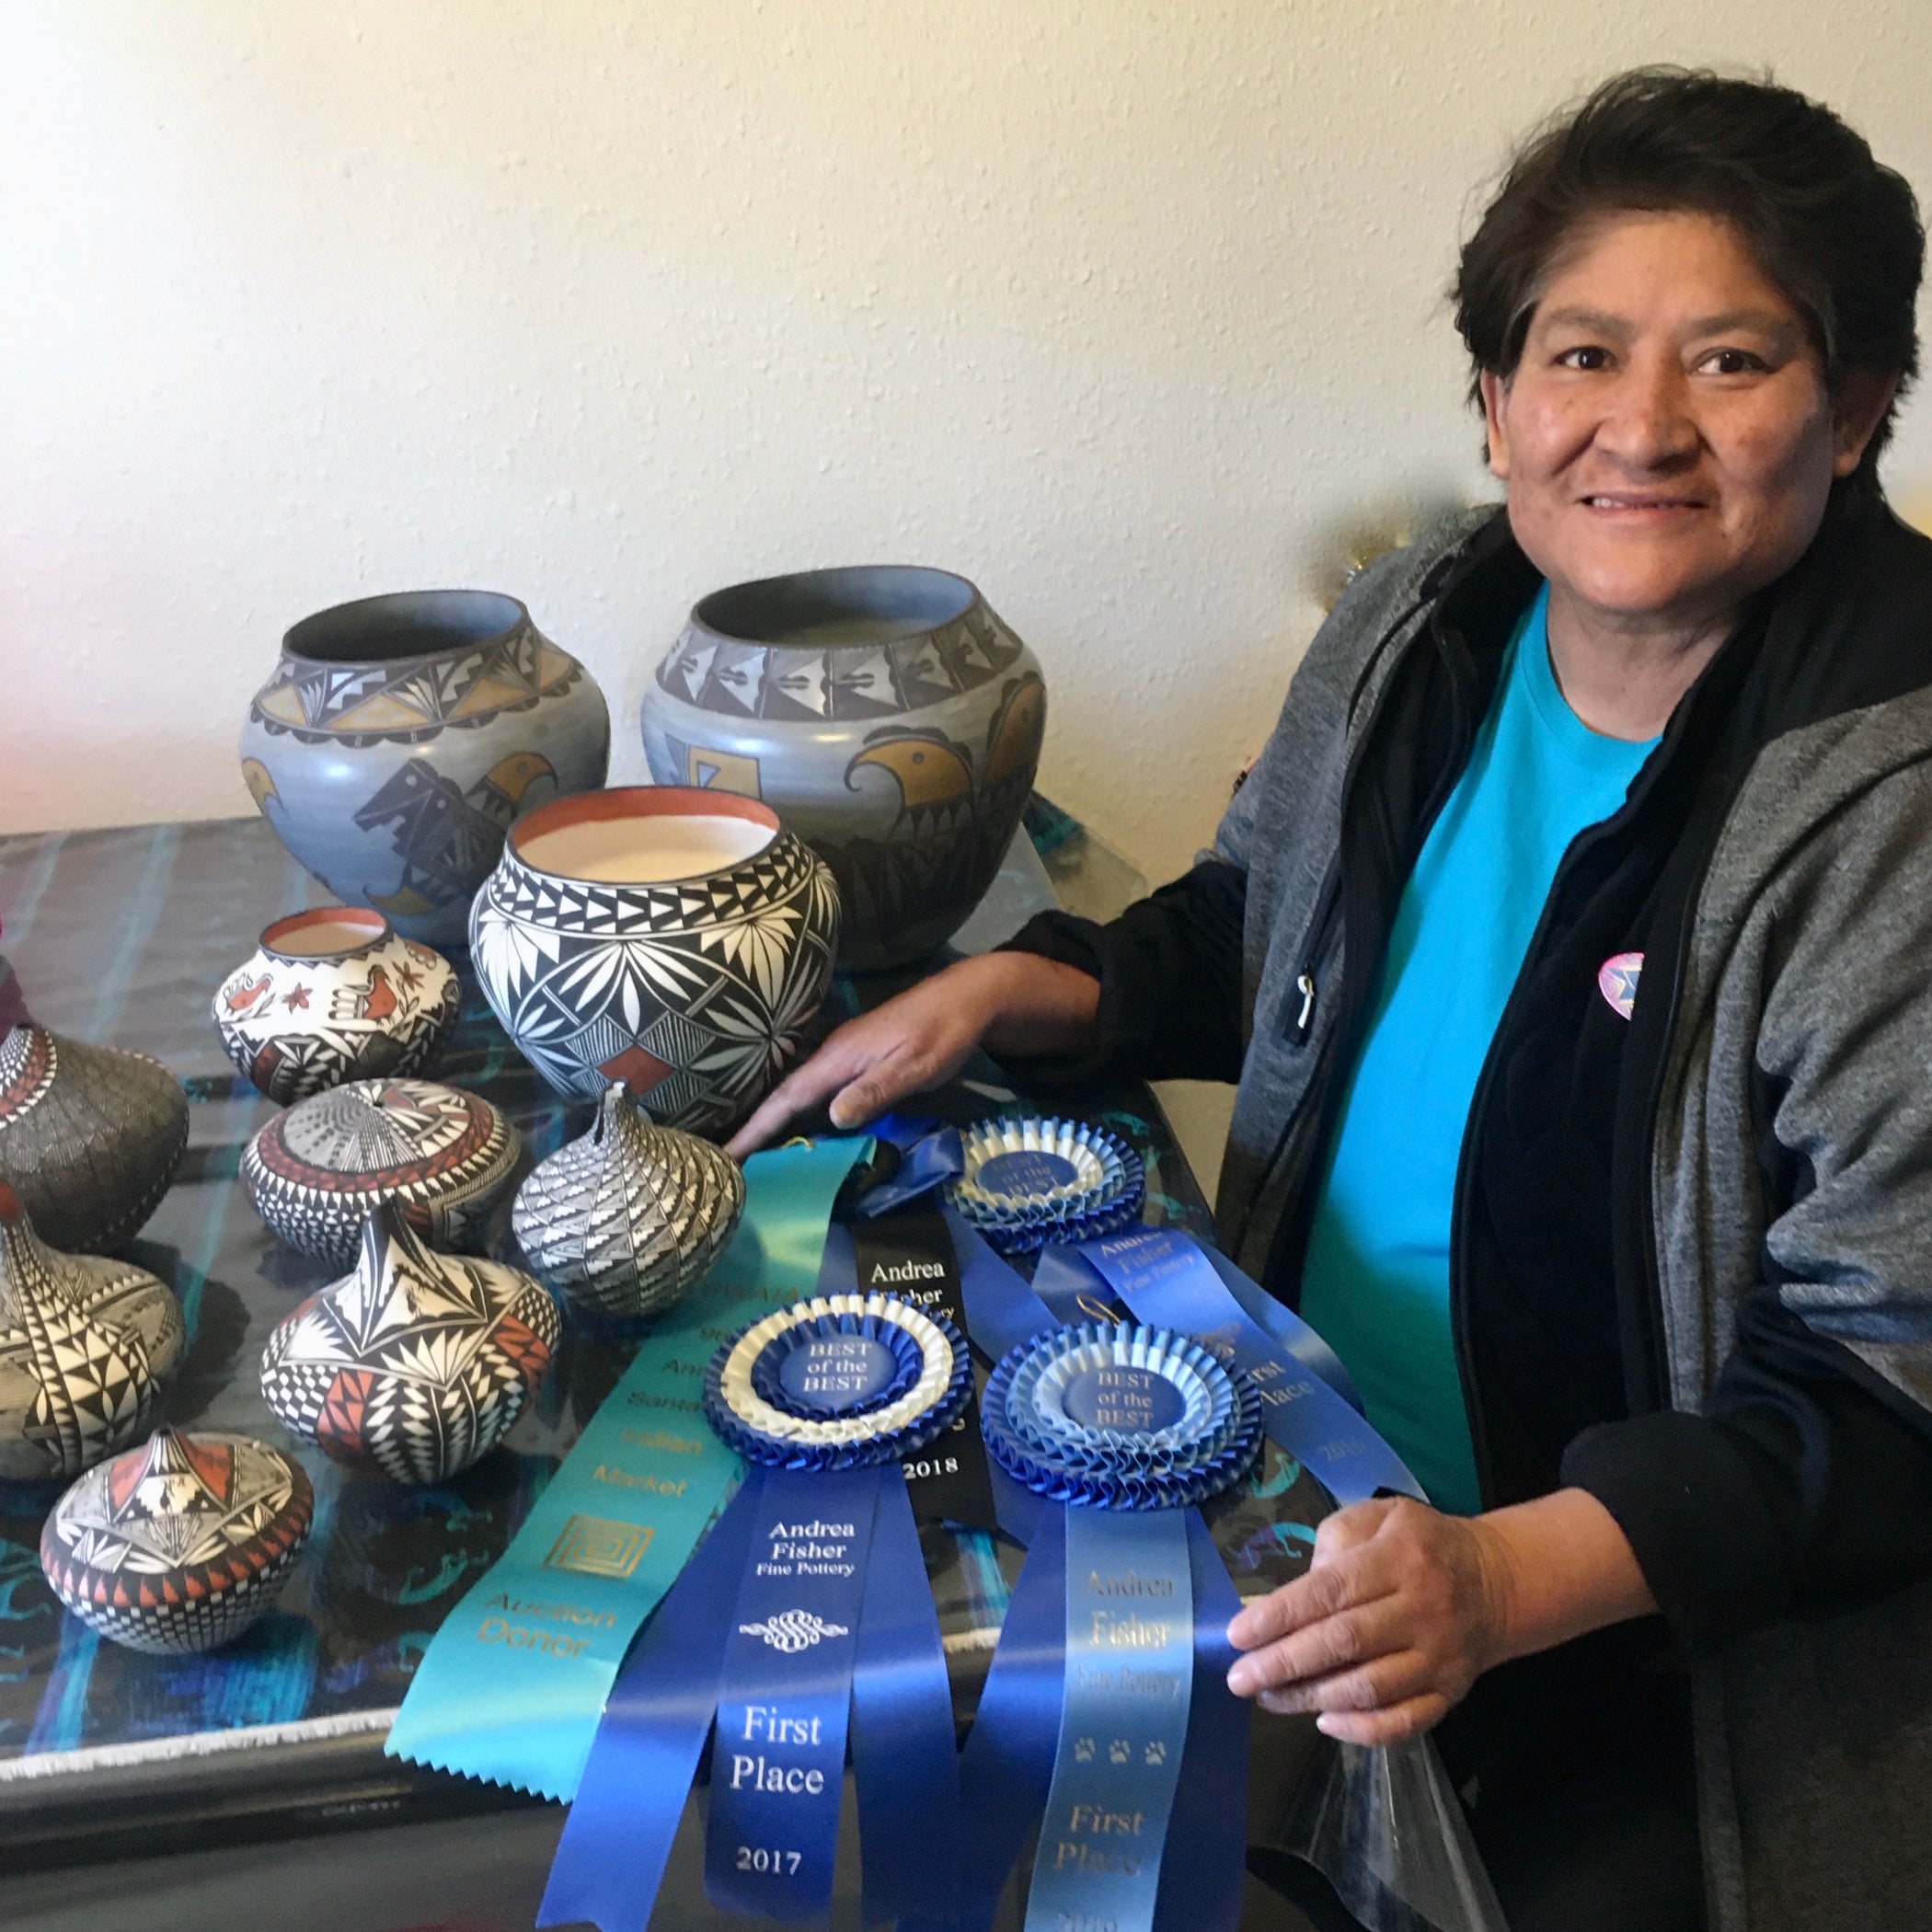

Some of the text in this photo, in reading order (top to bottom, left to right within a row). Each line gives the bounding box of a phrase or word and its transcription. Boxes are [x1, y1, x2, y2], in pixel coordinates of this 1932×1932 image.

[871, 1259, 946, 1283] Andrea
[810, 1342, 873, 1358] BEST
[807, 1358, 868, 1374] of the
[803, 1375, 868, 1393] BEST
[1098, 1371, 1155, 1389] BEST
[1098, 1391, 1154, 1409] of the
[1258, 1380, 1317, 1407] lace
[1097, 1409, 1155, 1428] BEST
[903, 1456, 959, 1480] 2018
[592, 1465, 687, 1499] Market
[769, 1520, 857, 1539] Andrea
[771, 1541, 847, 1560] Fisher
[756, 1561, 856, 1578] Fine Pottery
[1085, 1570, 1175, 1599] Andrea
[482, 1592, 619, 1630] Auction
[476, 1616, 592, 1660] Donor
[1088, 1611, 1172, 1650] Fisher
[742, 1705, 822, 1746] First
[729, 1754, 825, 1796] Place
[1069, 1803, 1144, 1835] First
[735, 1845, 803, 1876] 2017
